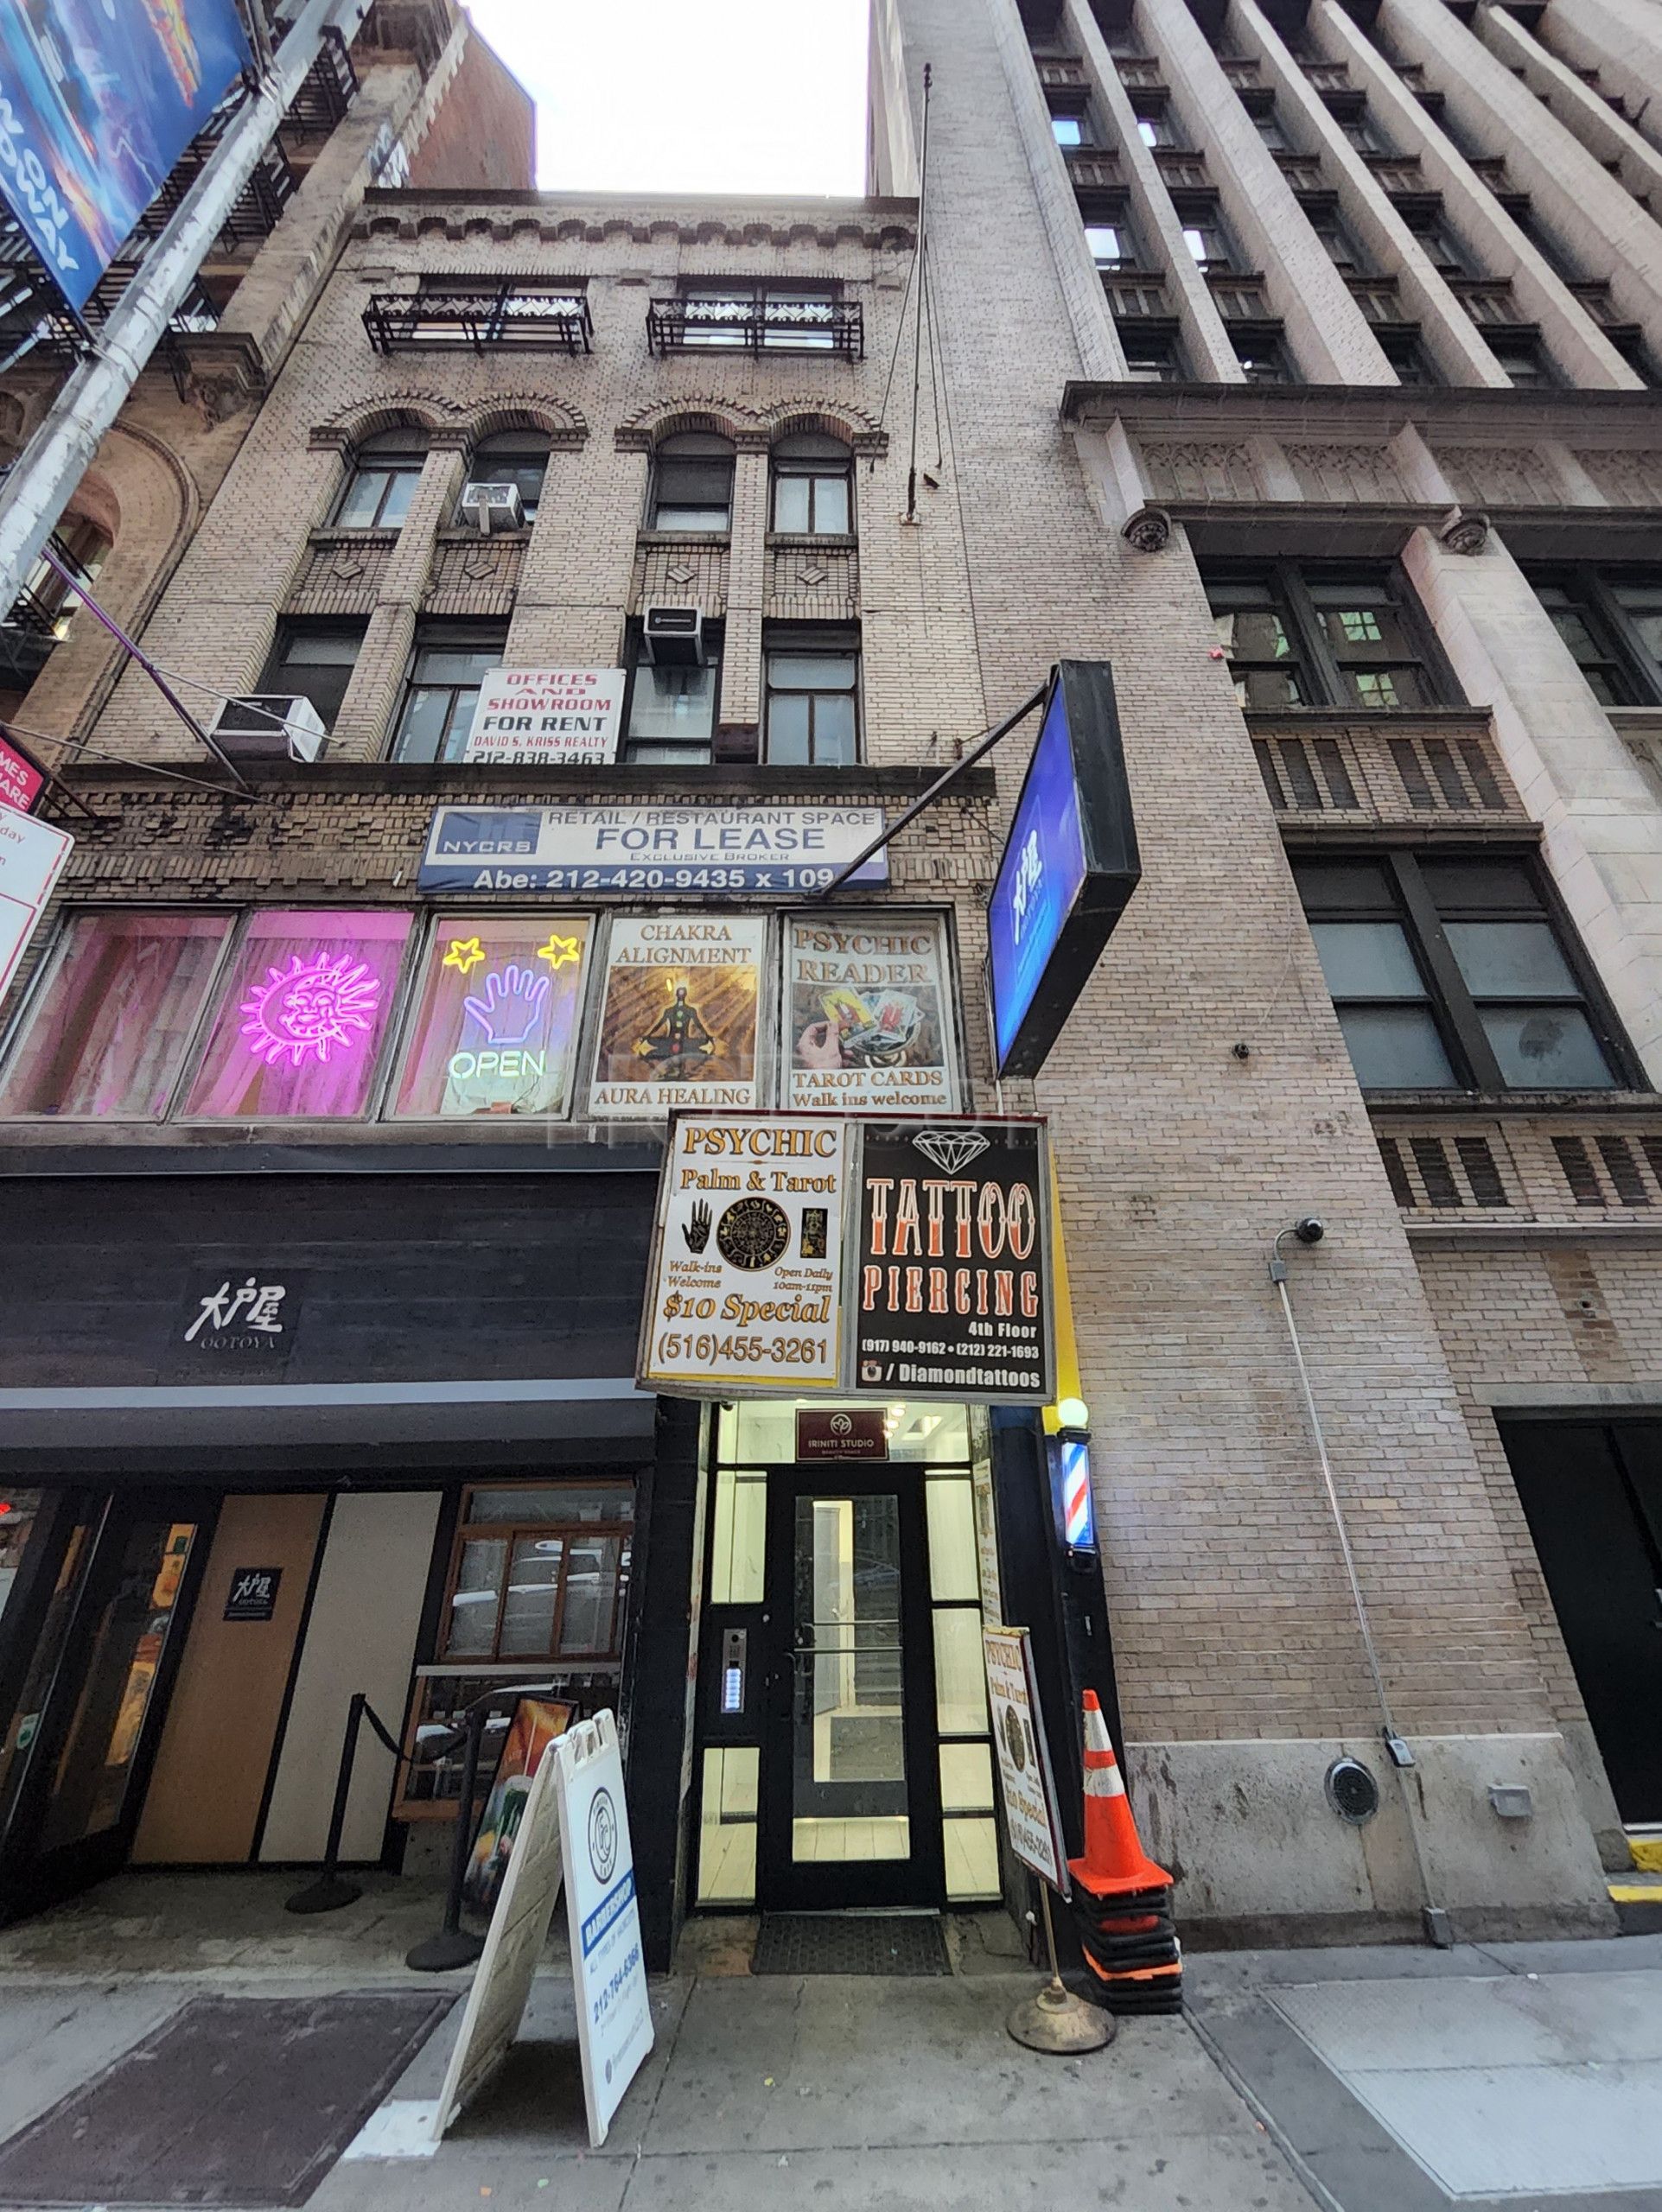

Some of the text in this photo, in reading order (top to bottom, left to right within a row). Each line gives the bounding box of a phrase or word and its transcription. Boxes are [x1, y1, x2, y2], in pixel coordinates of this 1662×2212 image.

[507, 673, 598, 686] OFFICES
[487, 698, 611, 711] SHOWROOM
[483, 716, 608, 732] FOR RENT
[474, 736, 609, 748] DAVID S. KRISS REALTY
[549, 811, 626, 824] RETAIL
[646, 811, 795, 825] RESTAURANT
[801, 812, 876, 825] SPACE
[595, 828, 825, 850] FOR LEASE
[630, 853, 720, 861] EXCLUSIVE
[474, 868, 835, 890] Abe: 212-420-9435 x 109
[640, 925, 733, 941] CHAKRA
[794, 928, 933, 956] PSYCHIC
[616, 948, 752, 963] ALIGNMENT
[798, 959, 932, 983] READER
[449, 1049, 546, 1079] OPEN
[793, 1071, 944, 1089] TAROT CARDS
[595, 1088, 752, 1105] AURA HEALING
[793, 1091, 947, 1107] Walk ins welcome
[683, 1126, 837, 1158] PSYCHIC
[680, 1168, 837, 1193] Palm & Tarot
[867, 1178, 1035, 1260] TATTOO
[669, 1260, 723, 1274] Walk-ins
[774, 1266, 832, 1282] Open Daily
[666, 1275, 723, 1290] Welcome
[863, 1265, 1039, 1318] PIERCING
[662, 1291, 831, 1327] $10 Special
[968, 1321, 1037, 1339] 4th Floor
[658, 1331, 827, 1366] (516)455-3261
[862, 1338, 1040, 1360] (917) 940-9162 (212) 221-1693
[899, 1363, 1041, 1388] Diamondtattoos
[841, 1439, 875, 1448] STUDIO
